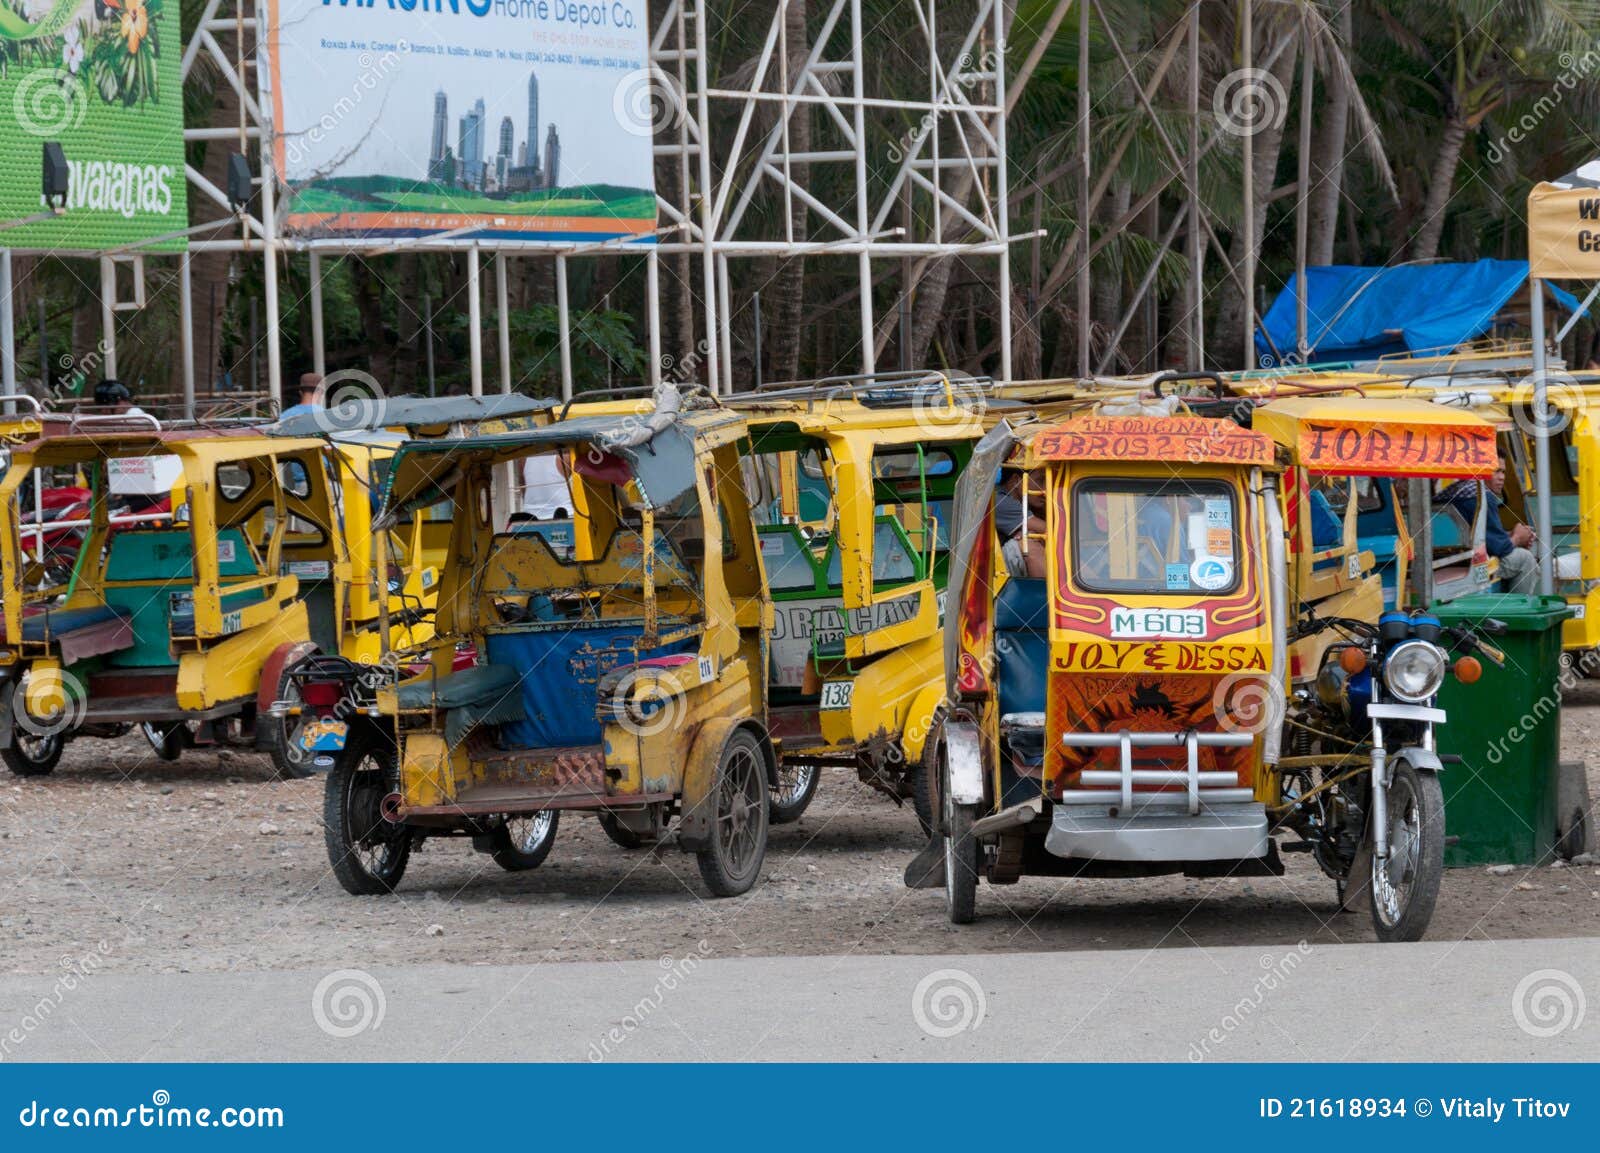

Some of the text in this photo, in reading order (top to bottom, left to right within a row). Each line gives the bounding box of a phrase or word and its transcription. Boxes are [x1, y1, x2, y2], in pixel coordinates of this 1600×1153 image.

[495, 0, 549, 20] Home
[555, 0, 607, 29] Depot
[612, 2, 637, 29] Co.
[41, 160, 172, 218] avaianas
[1083, 419, 1114, 432] THE
[1040, 436, 1266, 460] 5 BROS 2 SISTER
[1307, 423, 1491, 465] FOR HIRE
[1115, 613, 1204, 635] M-603
[1056, 643, 1143, 670] JOY
[1176, 645, 1266, 671] DESSA
